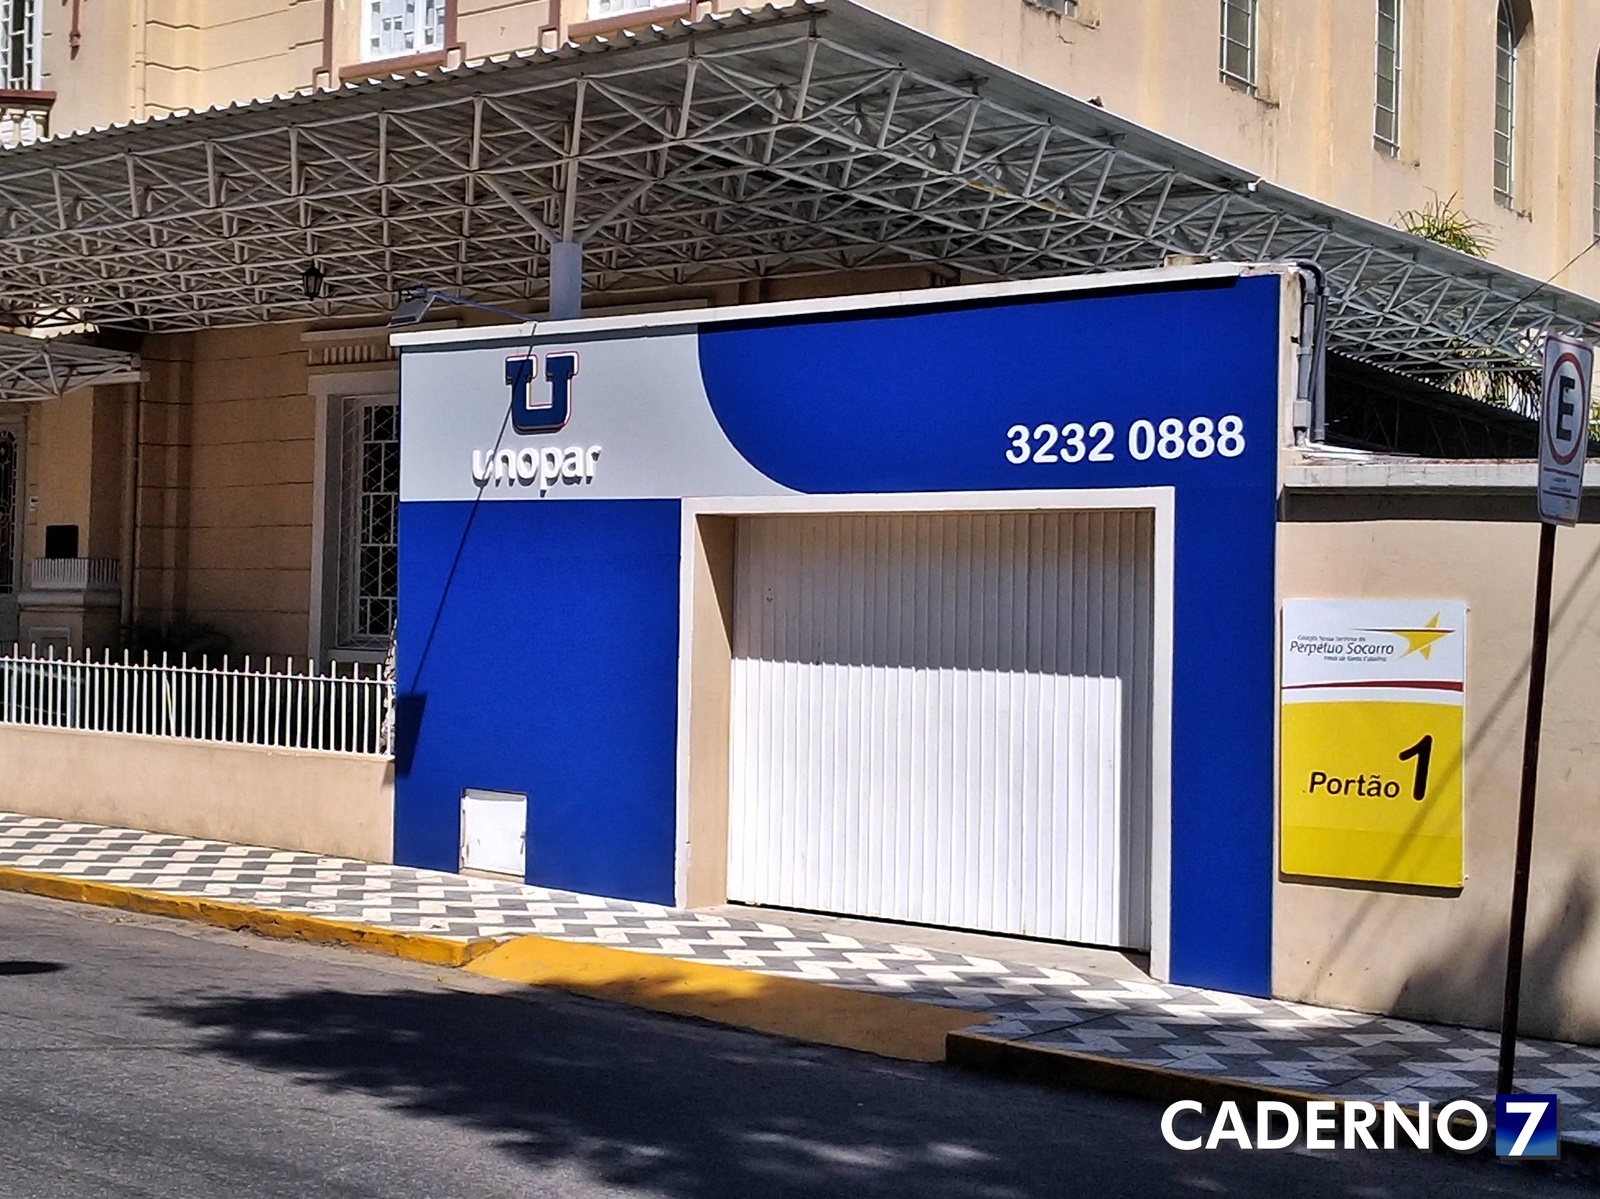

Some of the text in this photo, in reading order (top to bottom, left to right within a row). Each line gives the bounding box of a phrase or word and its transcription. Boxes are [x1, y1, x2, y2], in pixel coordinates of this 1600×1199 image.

[505, 351, 580, 434] U
[1556, 375, 1576, 442] E
[1006, 415, 1246, 464] 3232 0888
[472, 445, 602, 494] unopar
[1346, 642, 1395, 654] Socorro
[1309, 734, 1433, 801] Portão 1
